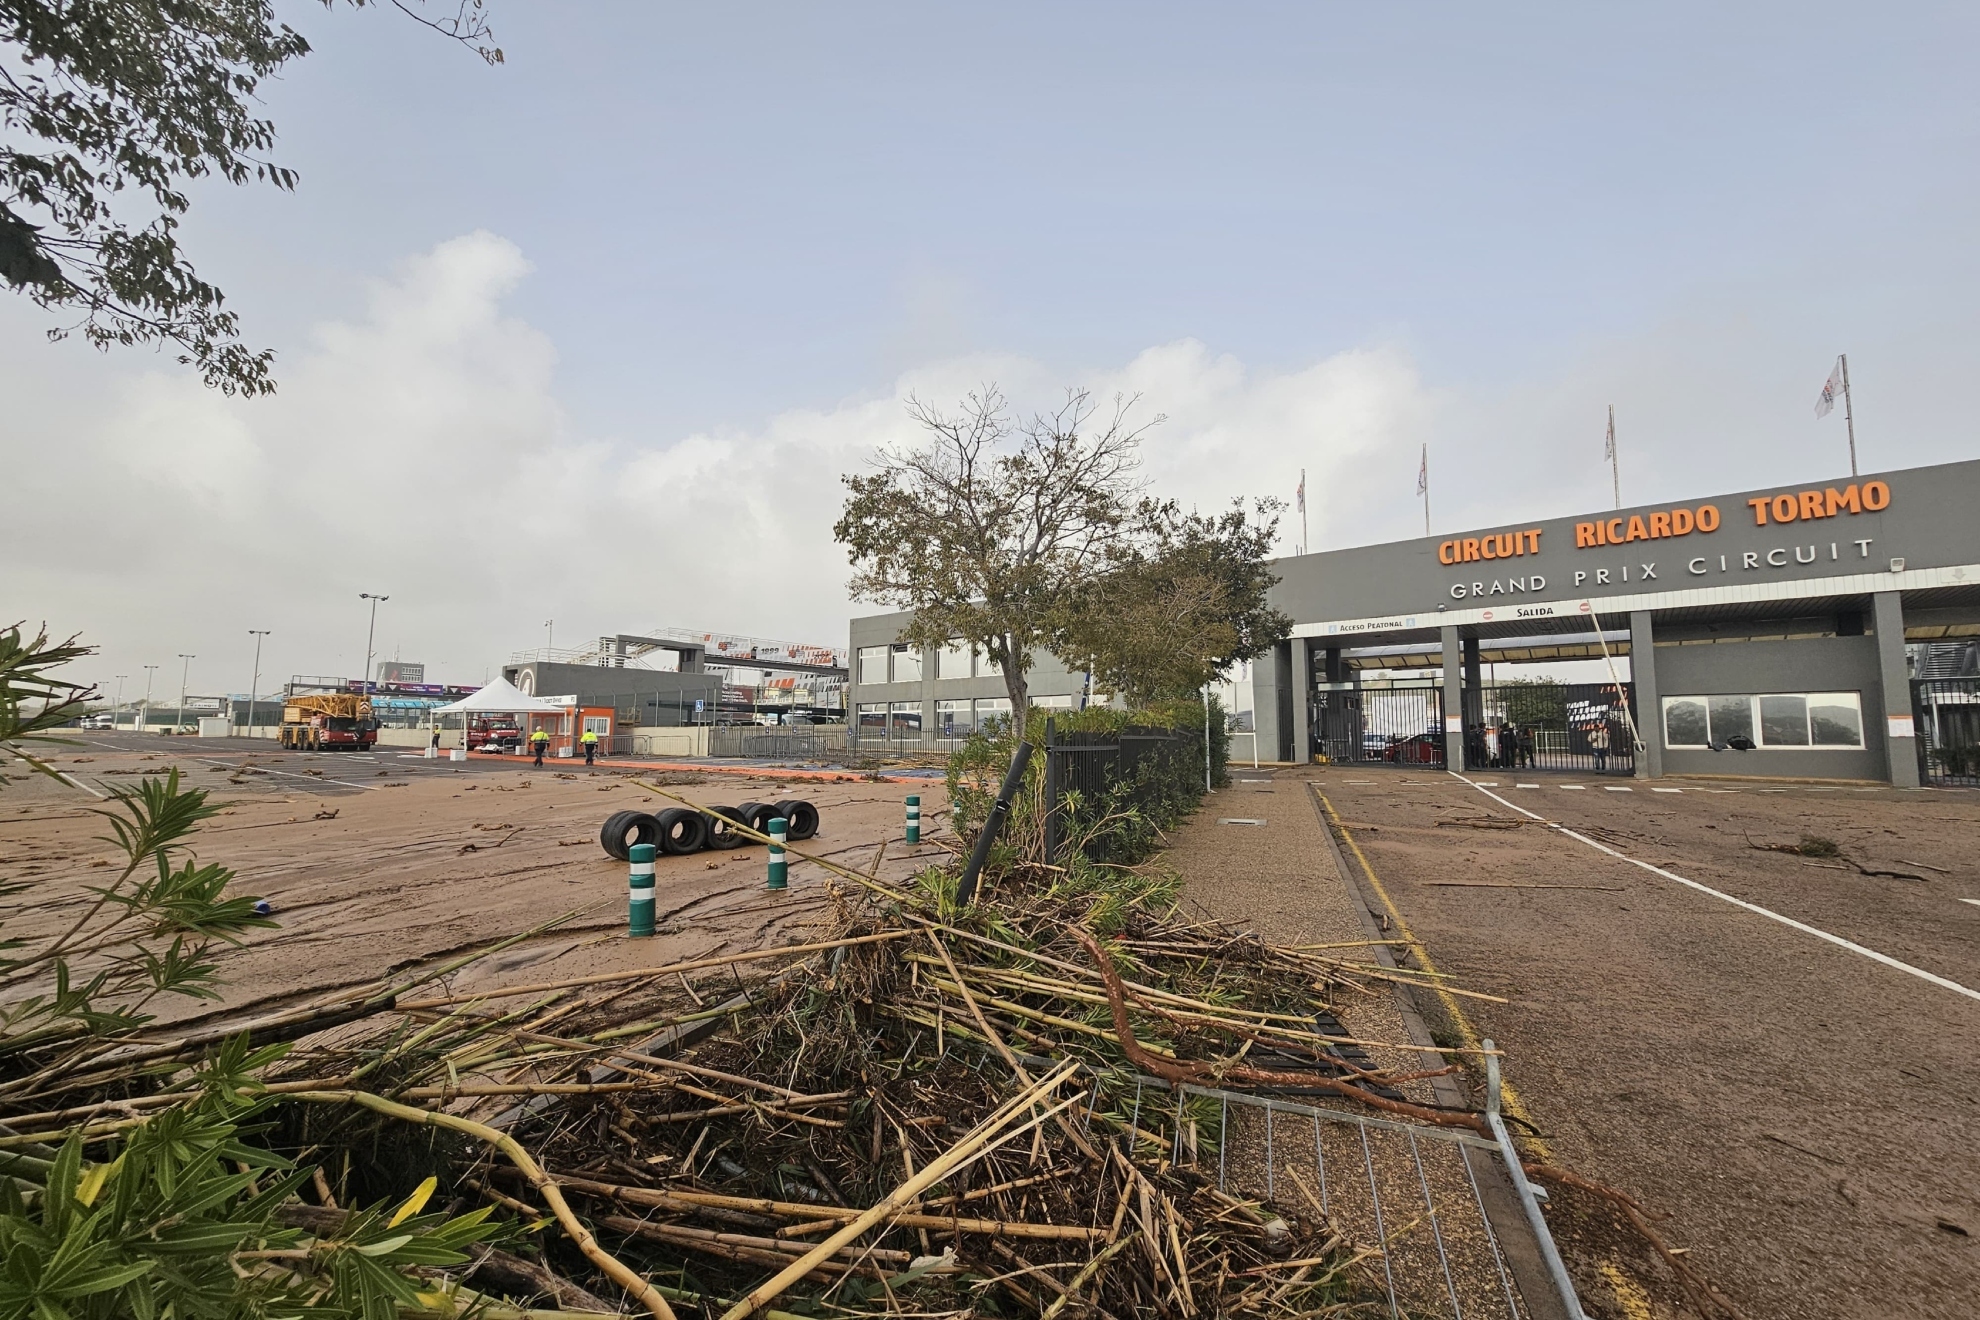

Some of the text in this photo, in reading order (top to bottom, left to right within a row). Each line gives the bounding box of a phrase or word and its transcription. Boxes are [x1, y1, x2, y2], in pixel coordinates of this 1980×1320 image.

[1438, 481, 1890, 564] CIRCUIT RICARDO TORMO
[1451, 539, 1873, 599] GRAND PRIX CIRCUIT
[1517, 607, 1554, 618] SALIDA
[1340, 624, 1365, 632] ACCESO
[760, 647, 780, 655] 1999
